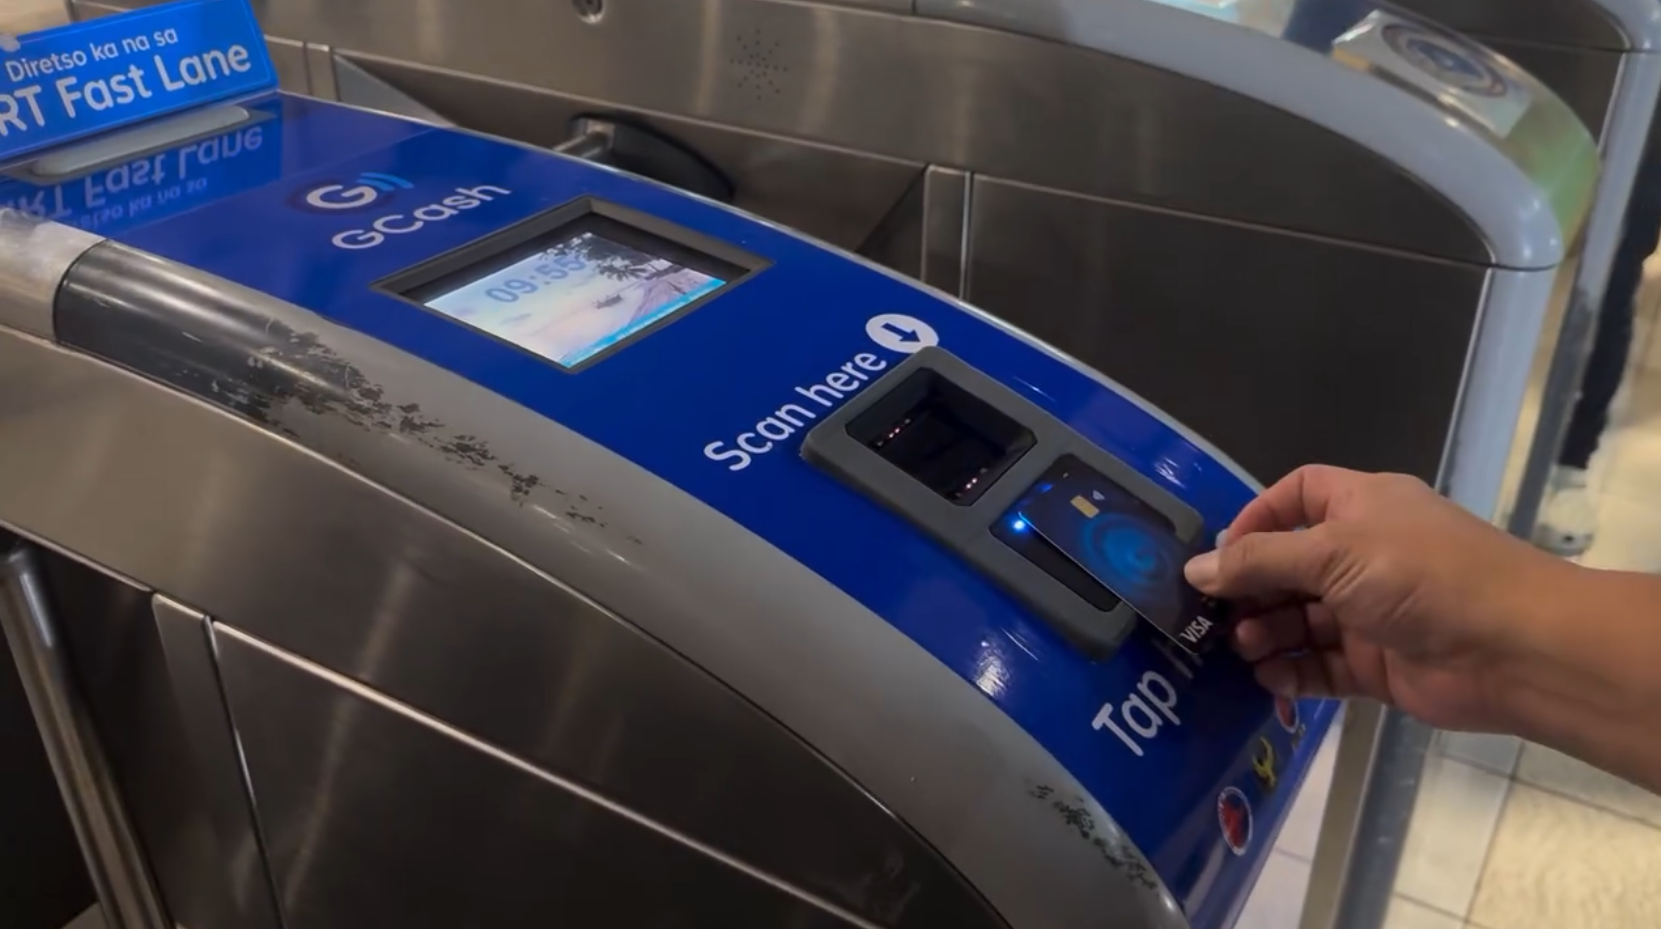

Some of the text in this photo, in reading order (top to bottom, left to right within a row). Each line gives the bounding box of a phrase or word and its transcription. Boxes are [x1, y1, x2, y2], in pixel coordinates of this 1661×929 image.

[5, 28, 179, 83] Diretso ka na sa
[56, 64, 153, 119] Fast
[154, 44, 252, 92] Lane
[331, 184, 512, 250] GCash
[485, 253, 587, 303] 09:55
[703, 352, 888, 471] Scan here
[1180, 615, 1214, 643] VISA
[1091, 670, 1181, 757] Tap
